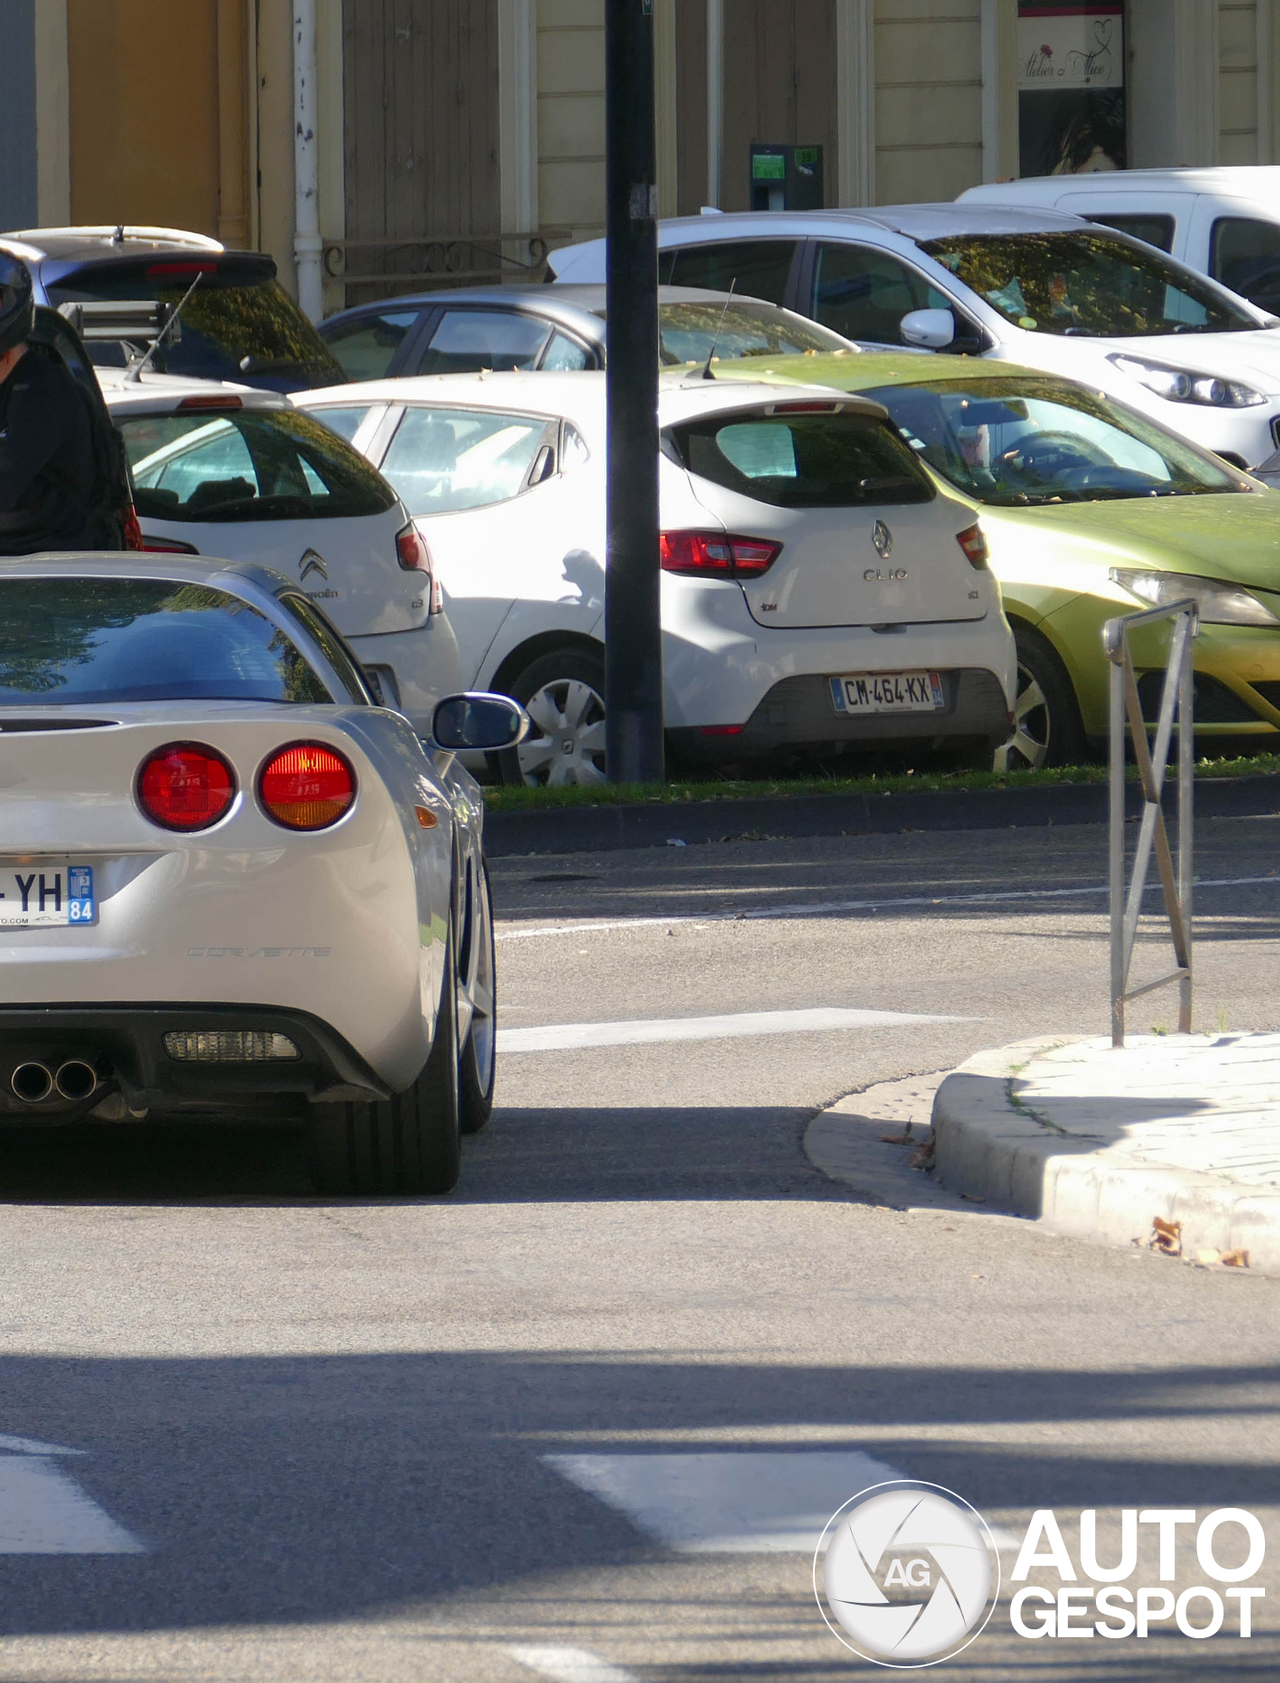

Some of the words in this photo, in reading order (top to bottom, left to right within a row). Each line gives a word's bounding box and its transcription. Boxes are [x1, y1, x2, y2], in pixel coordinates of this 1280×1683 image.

[863, 568, 908, 581] CLIO
[844, 678, 930, 706] CM-464-KX
[70, 901, 92, 920] 84
[185, 946, 332, 958] CORVETTE
